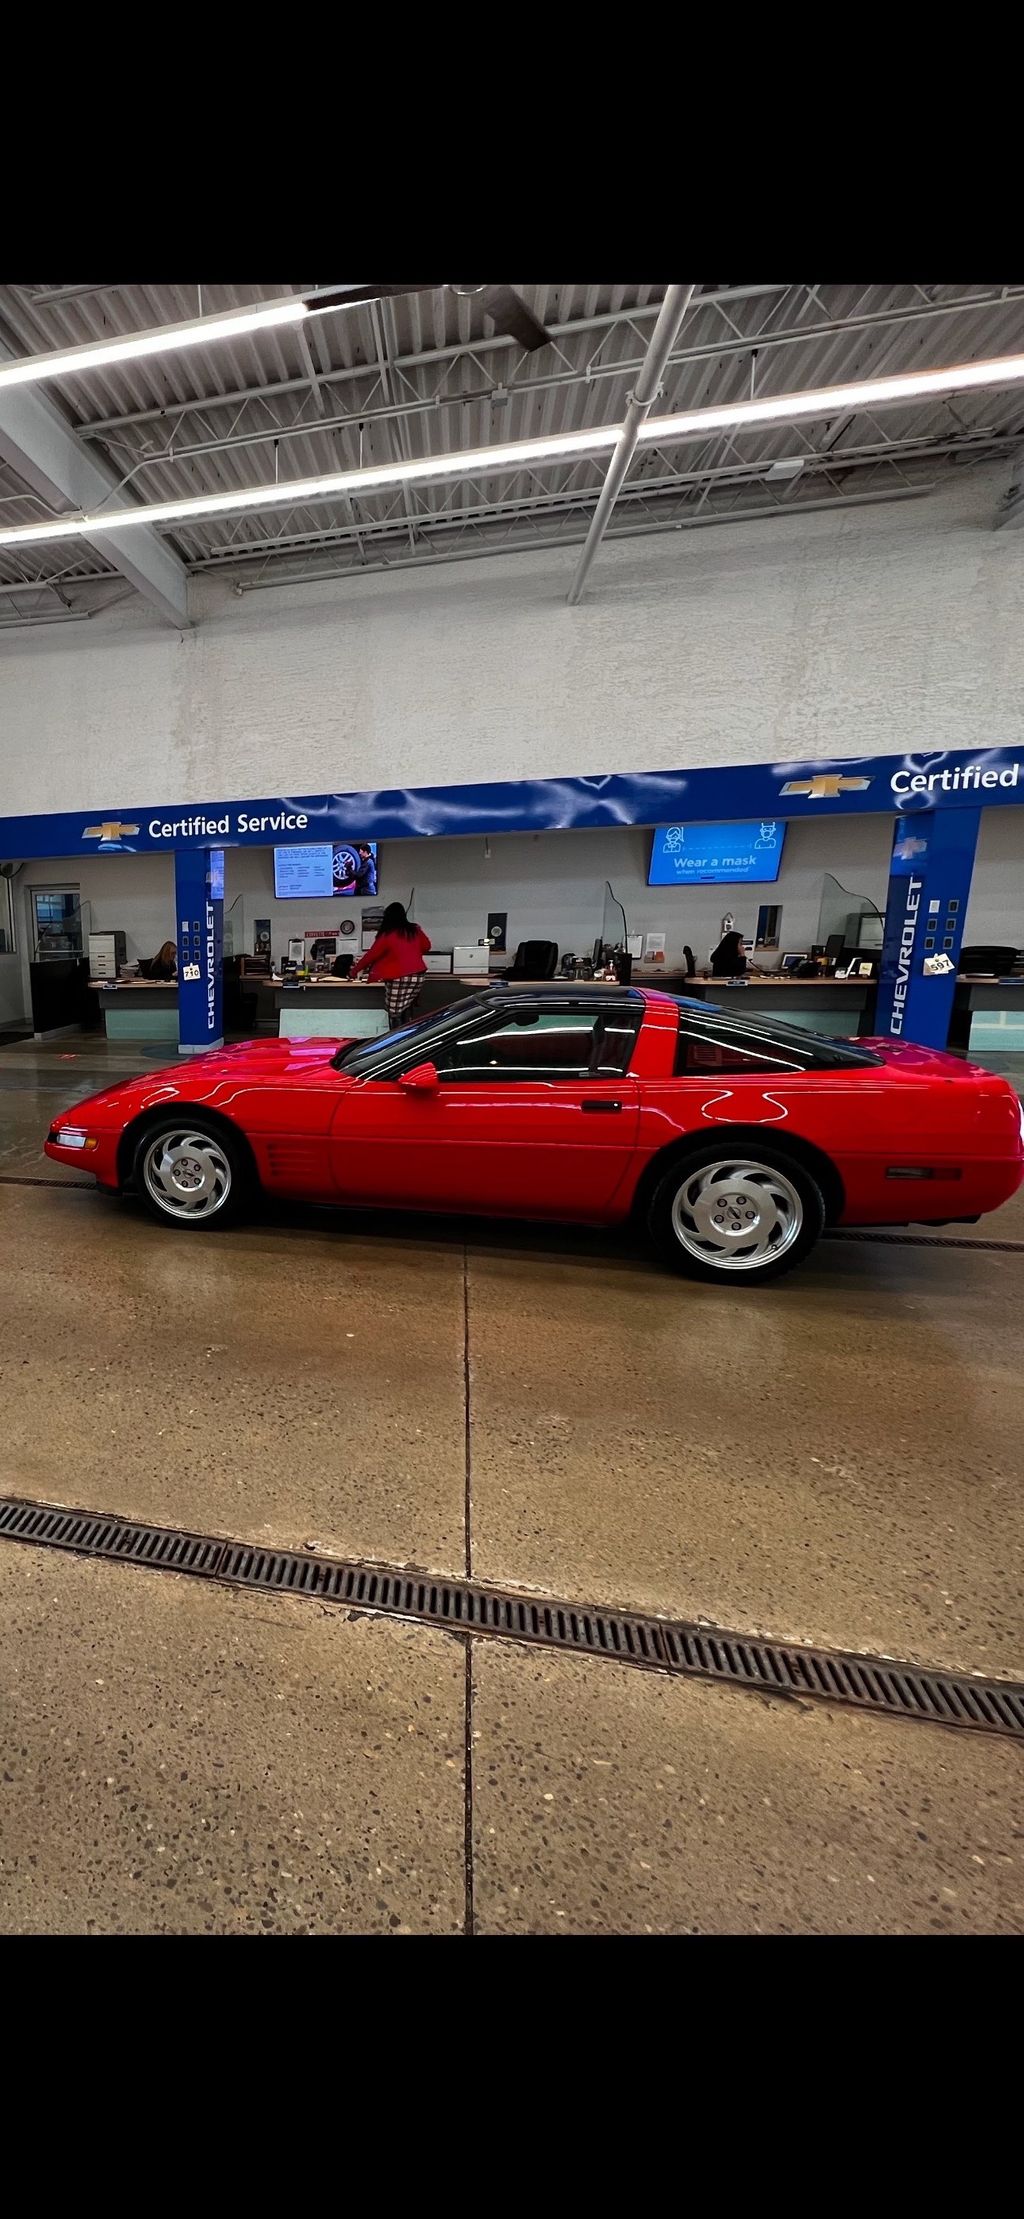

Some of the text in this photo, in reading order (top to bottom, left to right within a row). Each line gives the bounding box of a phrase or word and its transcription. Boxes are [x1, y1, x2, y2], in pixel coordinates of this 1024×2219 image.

[890, 763, 1020, 793] Certified
[148, 812, 308, 838] Certified Service
[674, 855, 757, 868] Wear a mask
[206, 901, 215, 1029] CHEVROLET
[890, 876, 922, 1034] CHEVROLET
[930, 959, 951, 972] 597
